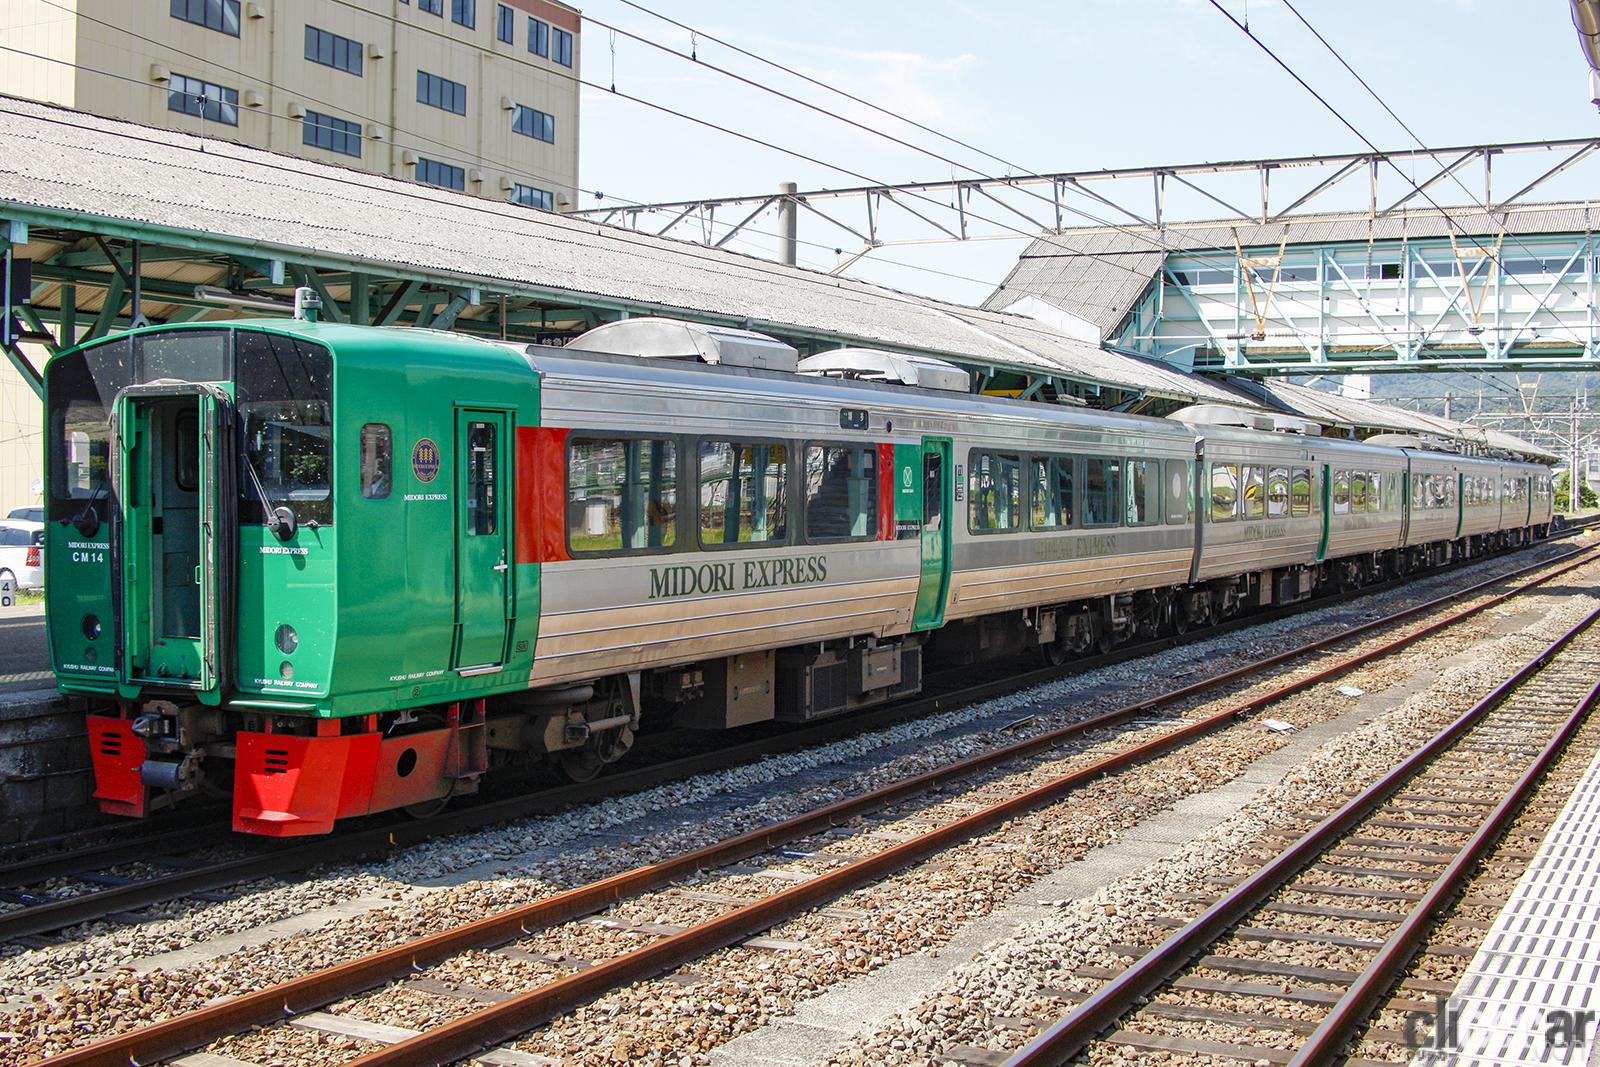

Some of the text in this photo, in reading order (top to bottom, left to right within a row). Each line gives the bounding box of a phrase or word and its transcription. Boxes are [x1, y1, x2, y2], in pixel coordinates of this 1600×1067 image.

[648, 555, 827, 599] MIDORI EXPRESS
[295, 681, 319, 689] COMPANY
